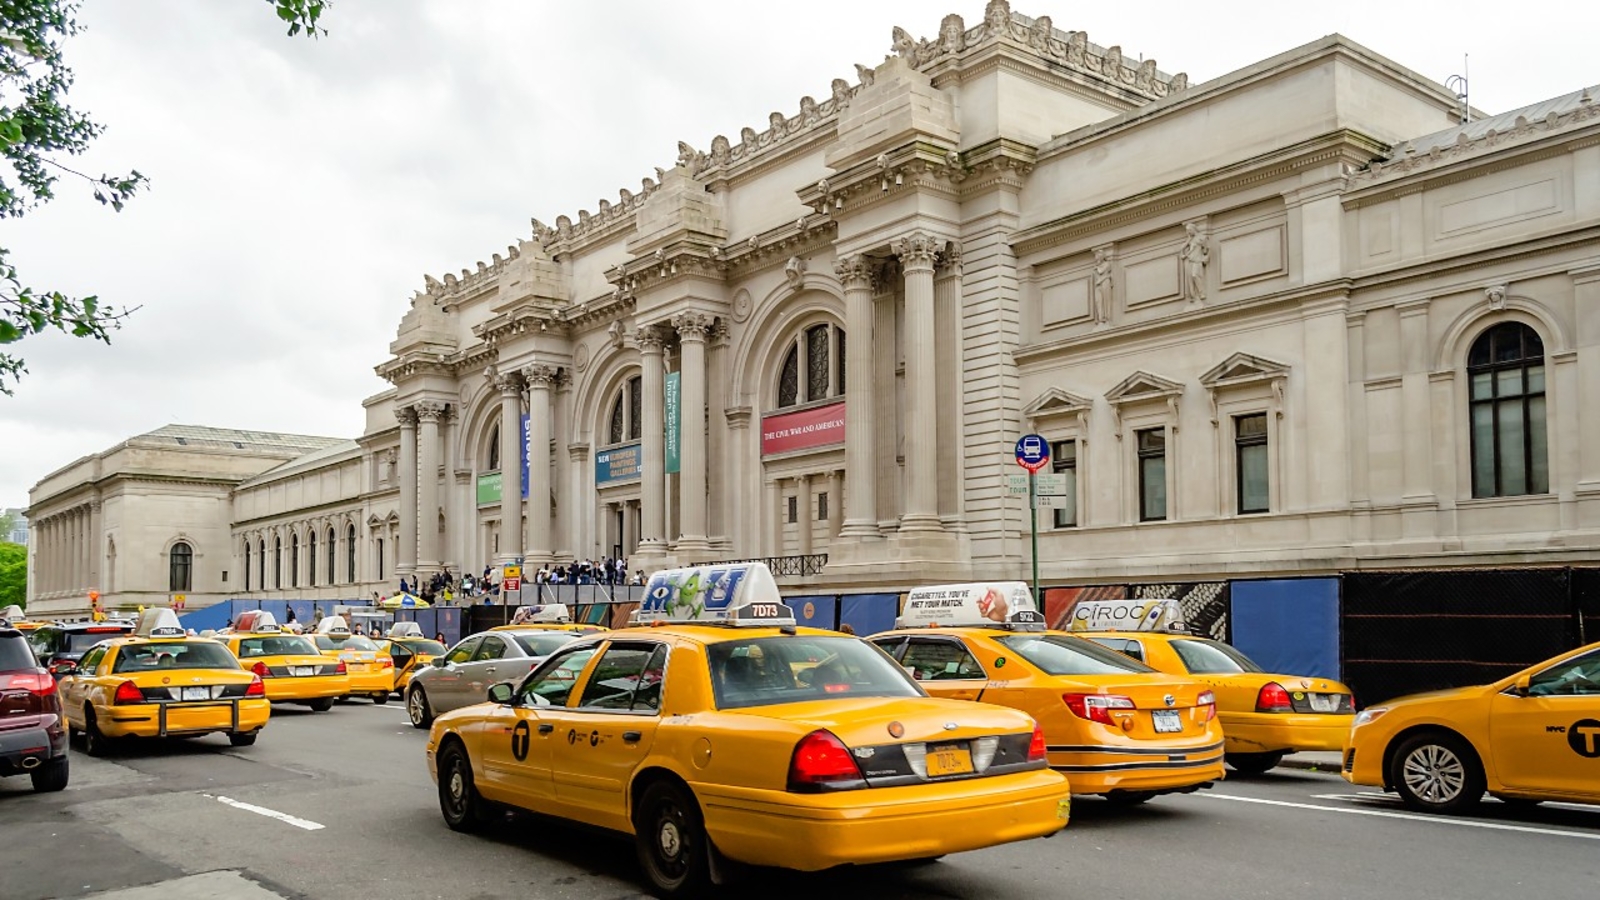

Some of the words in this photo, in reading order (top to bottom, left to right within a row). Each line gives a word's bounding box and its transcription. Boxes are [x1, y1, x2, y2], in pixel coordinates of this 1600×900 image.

[764, 432, 775, 441] THE
[775, 429, 790, 439] CIVIL
[790, 426, 802, 436] WAR
[802, 424, 815, 434] AND
[815, 419, 845, 431] AMERICAN
[598, 455, 609, 464] NEW
[948, 589, 971, 598] YOU'VE
[911, 600, 923, 609] MET
[924, 600, 940, 608] YOUR
[751, 604, 779, 617] 7D73
[1545, 725, 1566, 733] NYC
